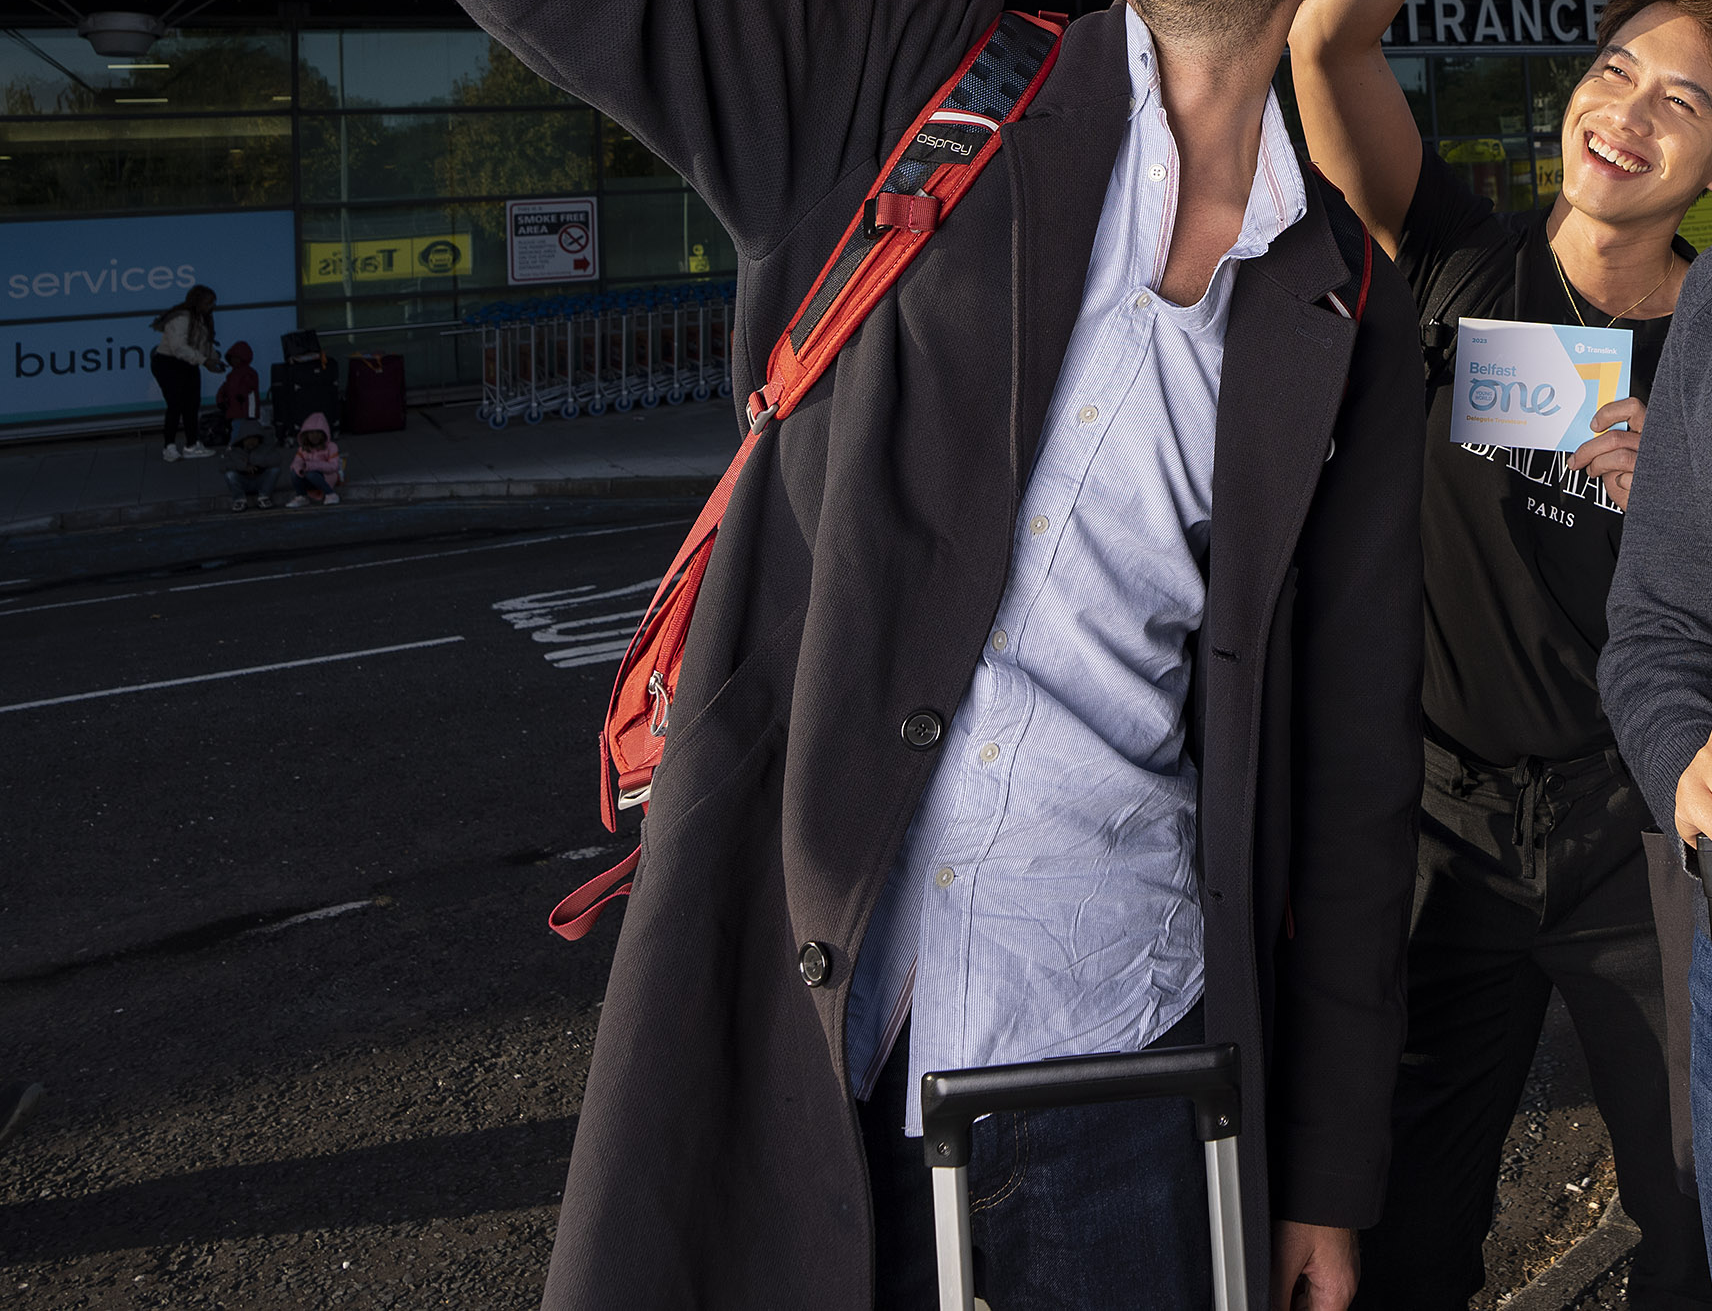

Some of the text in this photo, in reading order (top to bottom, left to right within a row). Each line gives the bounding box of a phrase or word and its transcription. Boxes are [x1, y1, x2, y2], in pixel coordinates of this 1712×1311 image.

[916, 133, 972, 156] osprey
[517, 212, 586, 225] SMOKE FREE
[517, 225, 549, 235] AREA
[8, 258, 196, 299] services
[15, 337, 150, 378] busin
[1587, 346, 1618, 355] Translink
[1469, 362, 1517, 377] Belfast
[1527, 497, 1576, 527] PARIS
